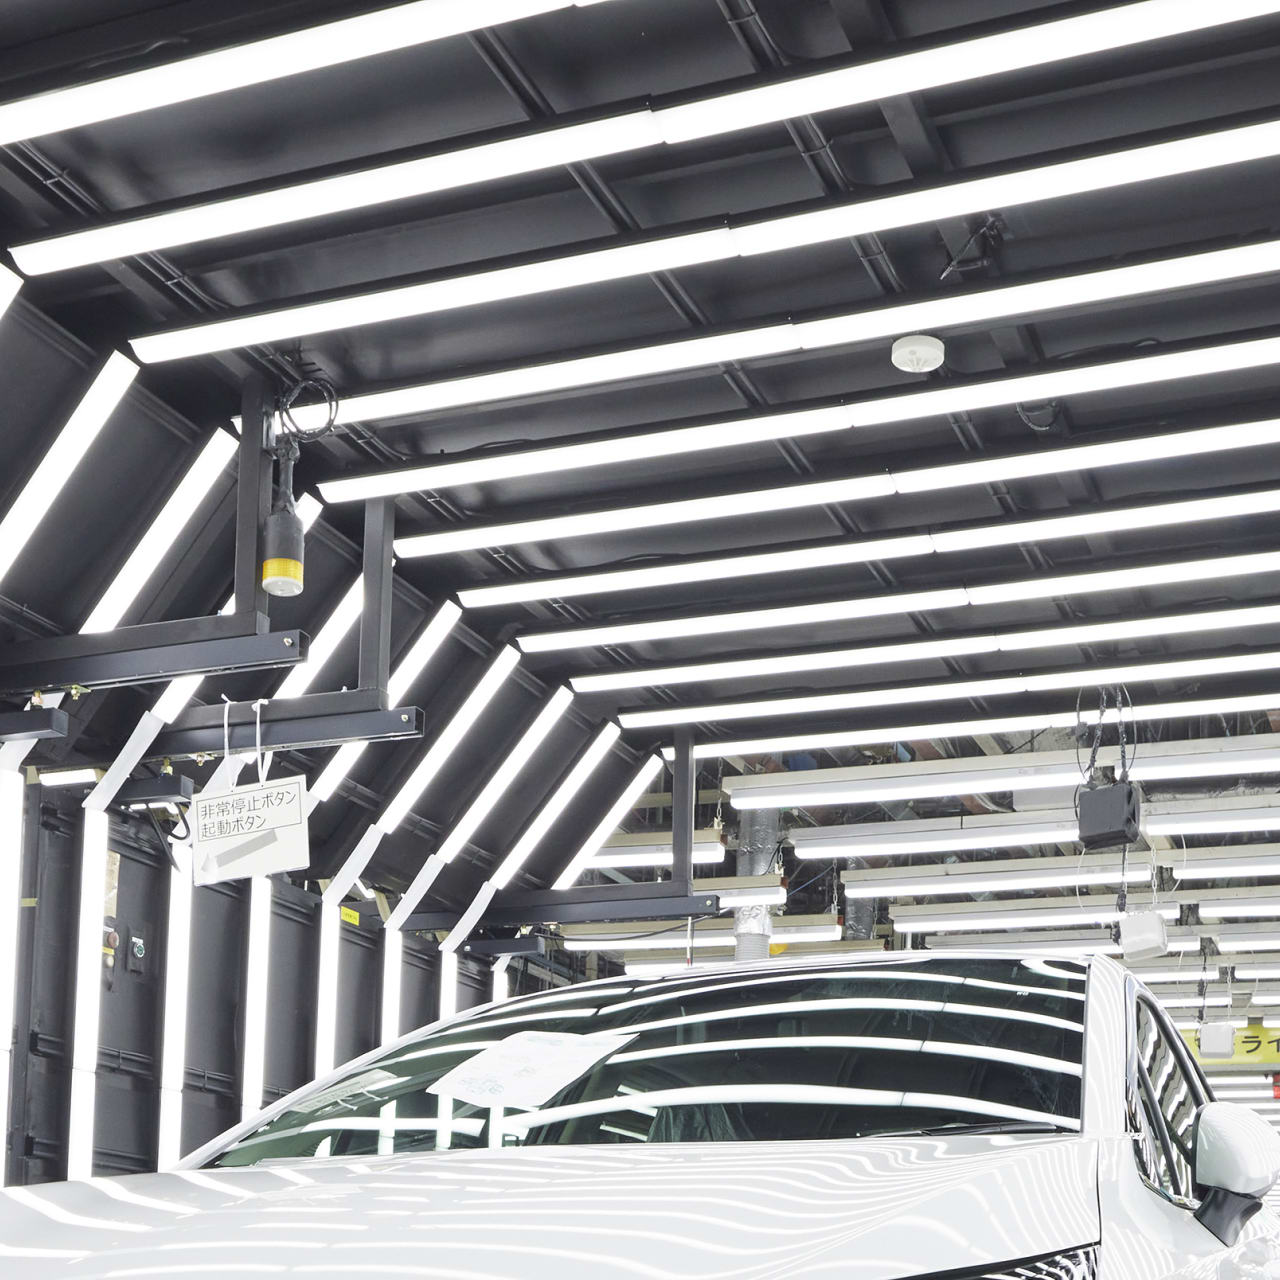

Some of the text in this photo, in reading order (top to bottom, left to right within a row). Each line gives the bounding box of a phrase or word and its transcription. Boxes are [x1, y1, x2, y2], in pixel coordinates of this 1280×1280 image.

[200, 790, 297, 820] 非常停止ボタン
[201, 816, 267, 838] 起動ボタン
